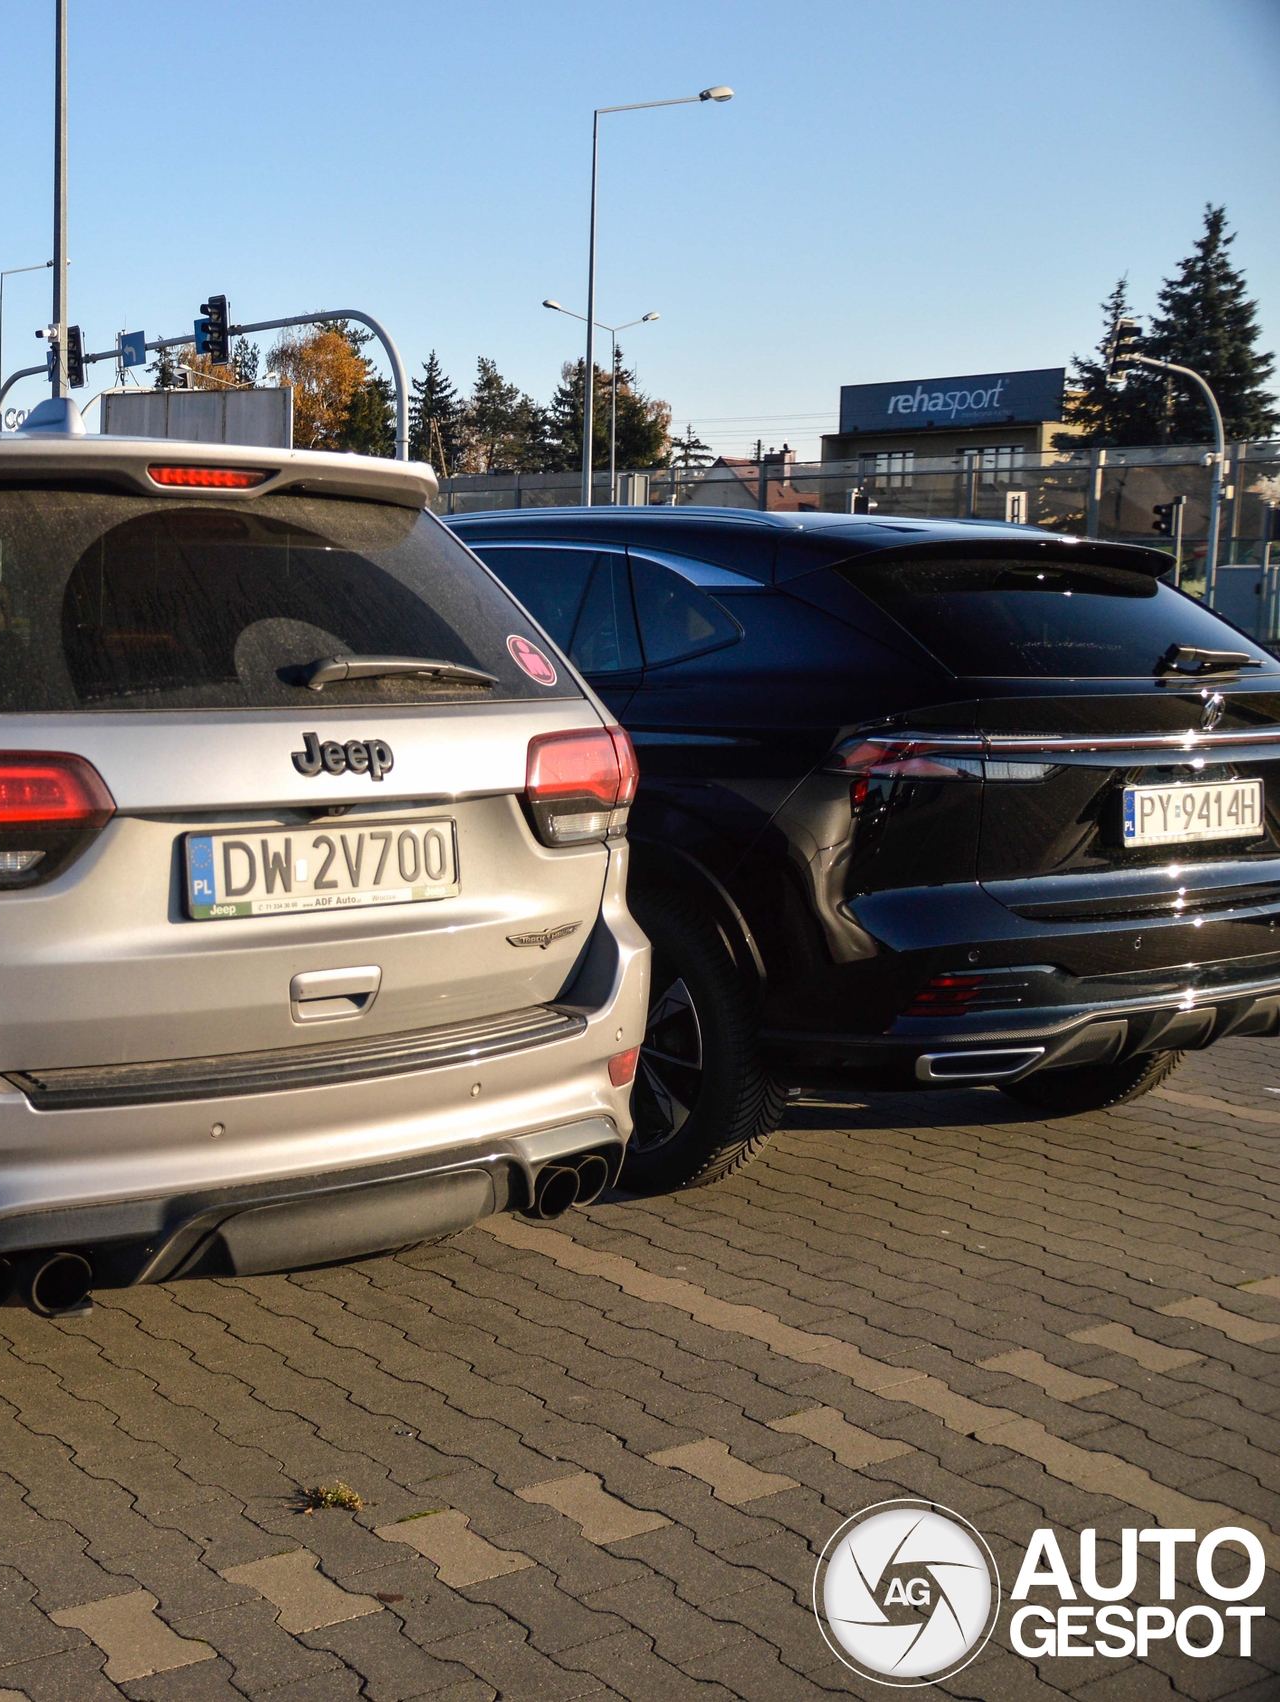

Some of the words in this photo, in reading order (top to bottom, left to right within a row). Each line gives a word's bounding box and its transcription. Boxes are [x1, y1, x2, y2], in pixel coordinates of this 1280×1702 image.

[886, 379, 1004, 419] rehasport
[291, 730, 394, 782] Jeep
[1124, 821, 1134, 831] PL
[1140, 793, 1172, 833] PY
[1182, 788, 1255, 830] 9414H
[222, 837, 293, 897] DW
[312, 827, 447, 890] 2V700
[193, 880, 212, 895] PL
[210, 904, 236, 916] Jeep
[424, 886, 446, 896] Jeep
